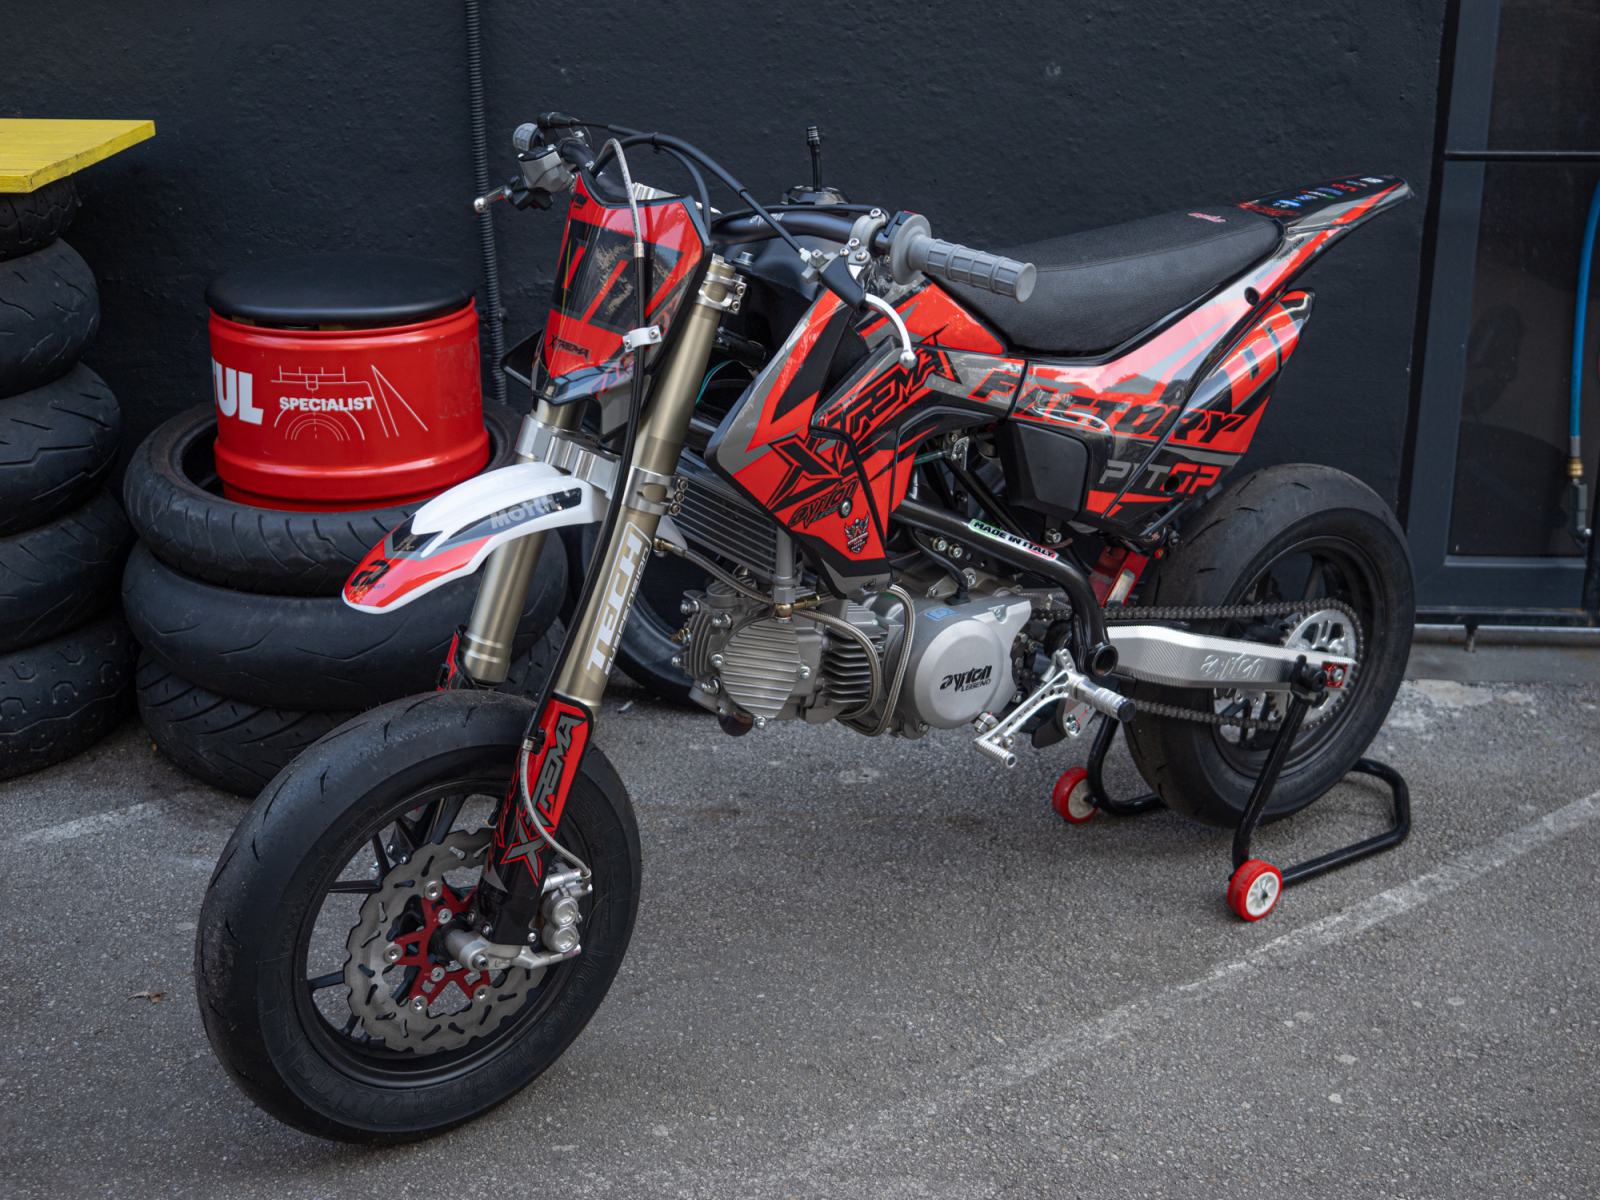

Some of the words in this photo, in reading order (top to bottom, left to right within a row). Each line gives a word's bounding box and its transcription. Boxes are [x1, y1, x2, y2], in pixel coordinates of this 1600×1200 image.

[211, 356, 265, 426] UL
[279, 396, 375, 412] SPECIALIST
[967, 367, 1247, 444] FACTORY
[973, 521, 1006, 540] MADE
[1008, 534, 1022, 545] IN
[1022, 539, 1056, 557] ITALY
[586, 531, 643, 672] TECH
